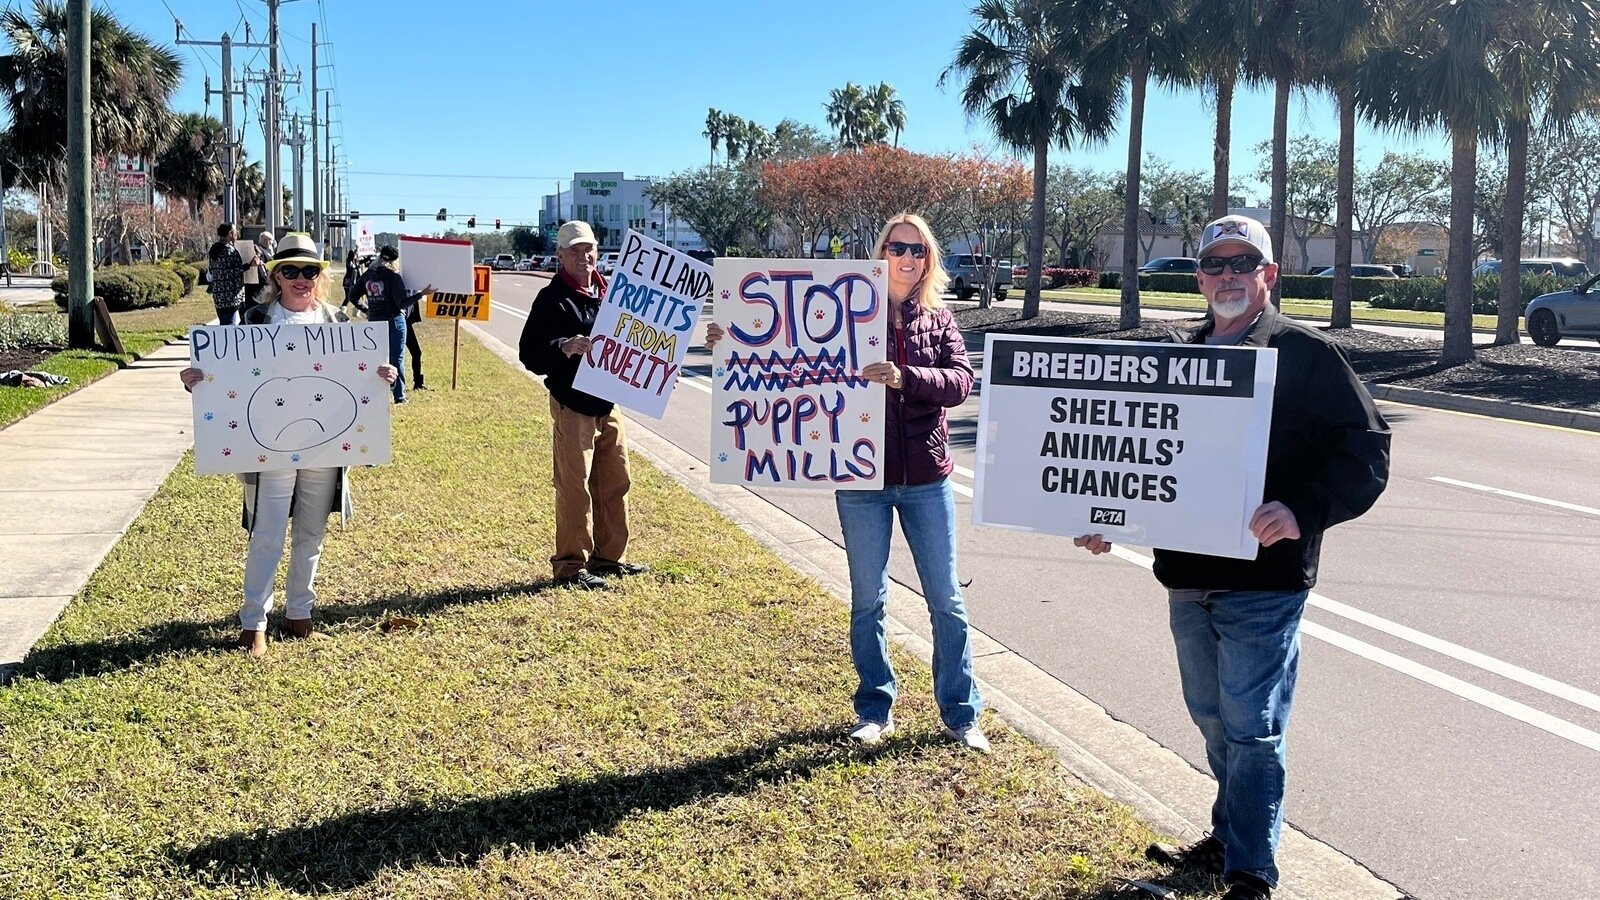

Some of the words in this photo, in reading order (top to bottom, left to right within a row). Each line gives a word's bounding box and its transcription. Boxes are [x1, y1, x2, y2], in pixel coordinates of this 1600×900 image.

[620, 234, 713, 301] PETLAND
[432, 292, 485, 306] DON'T
[435, 304, 479, 318] BUY!
[608, 272, 697, 332] PROFITS
[614, 312, 677, 363] FROM
[727, 270, 880, 371] STOP
[192, 325, 281, 362] PUPPY
[304, 325, 378, 355] MILLS
[586, 334, 678, 396] CRUELTY
[1012, 350, 1159, 384] BREEDERS
[1167, 357, 1233, 388] KILL
[722, 390, 846, 451] PUPPY
[1050, 396, 1180, 431] SHELTER
[744, 437, 877, 483] MILLS
[1039, 431, 1185, 467] ANIMALS'
[1041, 466, 1178, 503] CHANCES
